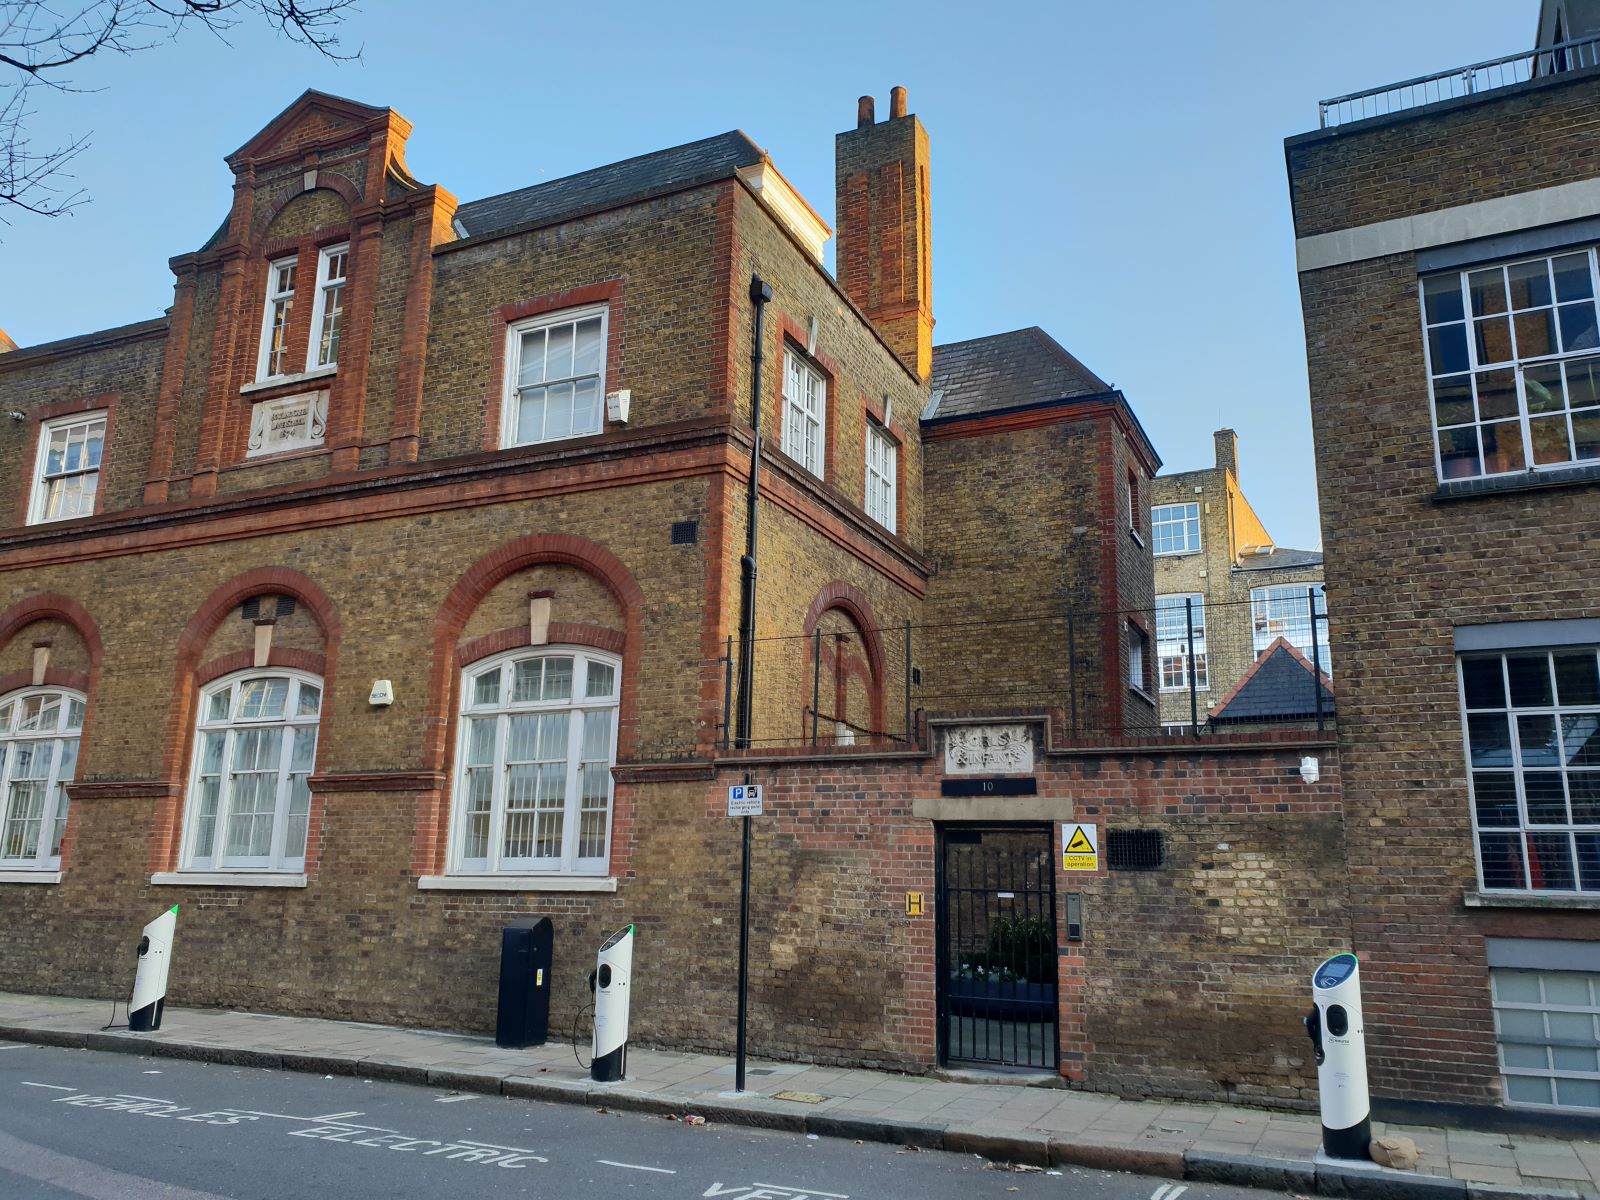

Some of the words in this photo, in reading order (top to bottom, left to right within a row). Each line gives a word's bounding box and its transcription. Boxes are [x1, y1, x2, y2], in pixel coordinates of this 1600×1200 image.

[968, 751, 1021, 764] INFANTS
[983, 781, 994, 791] 10
[908, 894, 922, 913] H
[52, 1094, 260, 1125] VEHICLES
[288, 1126, 549, 1169] ELECTRIC
